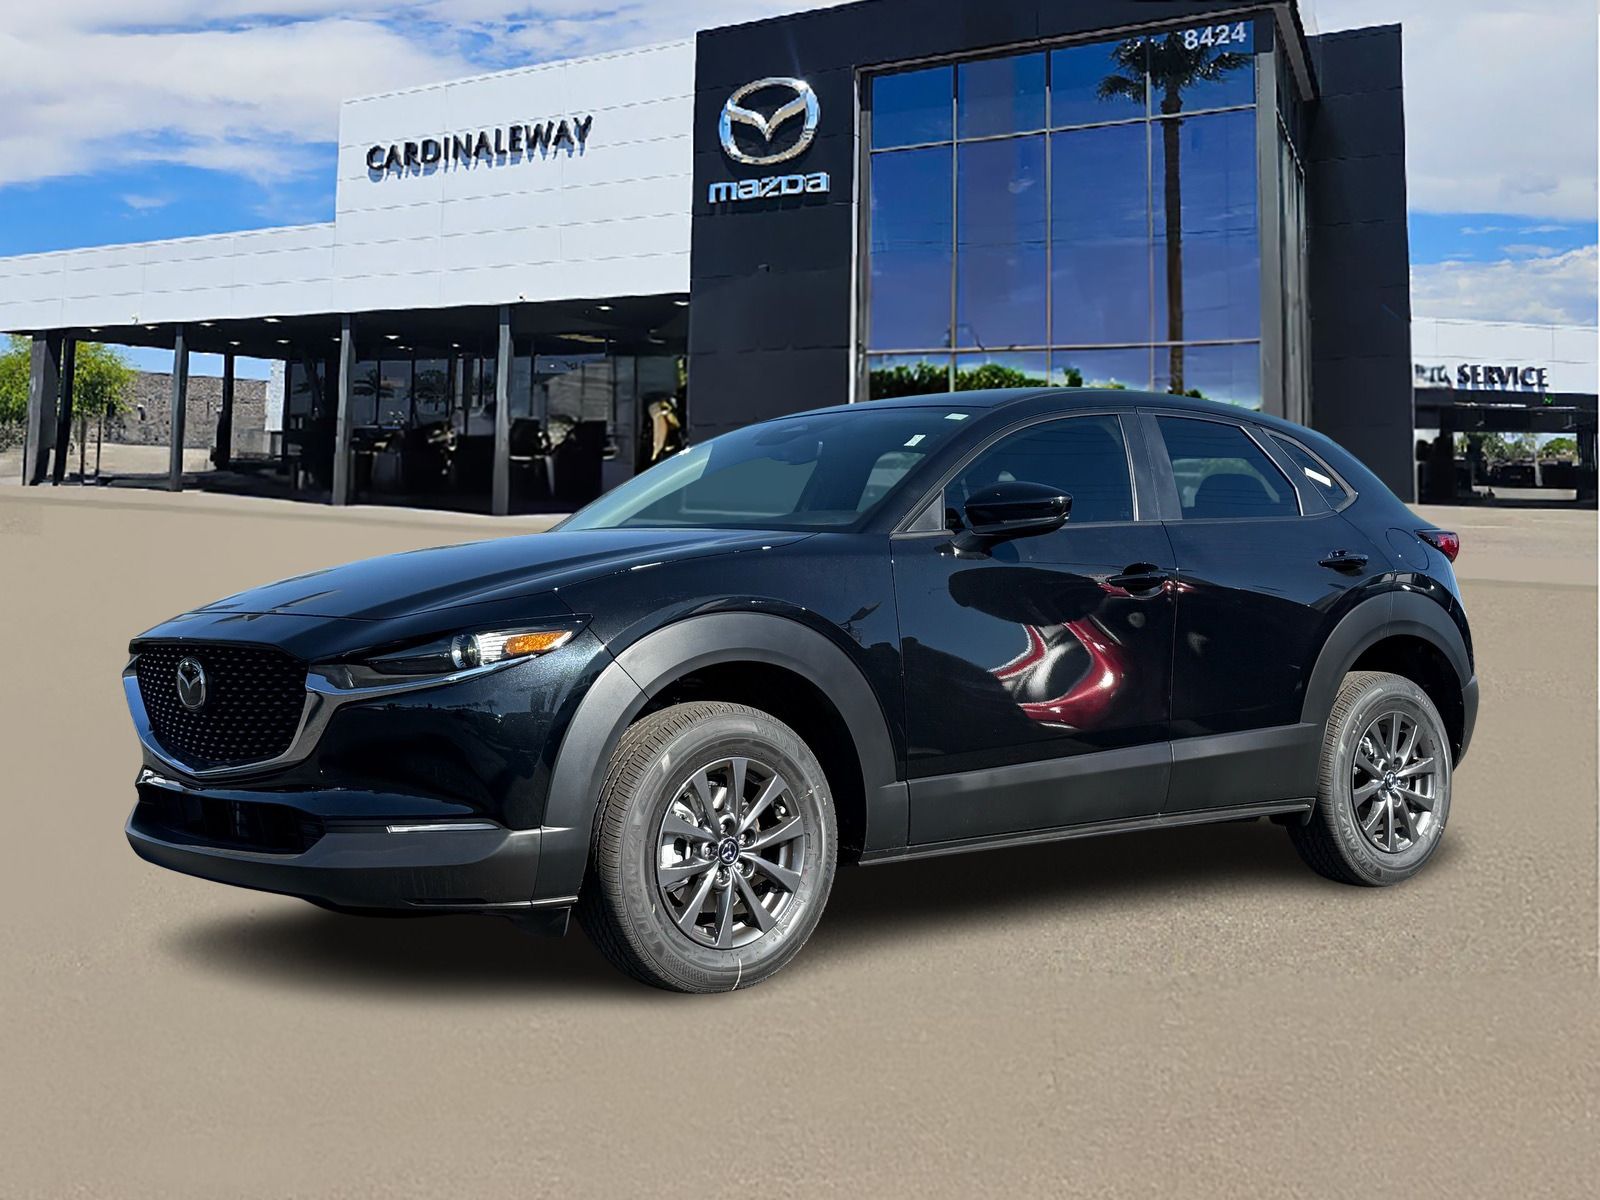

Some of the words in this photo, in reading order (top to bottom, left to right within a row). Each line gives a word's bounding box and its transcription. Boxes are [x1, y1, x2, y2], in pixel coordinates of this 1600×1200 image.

[1184, 21, 1247, 50] 8424
[366, 115, 593, 171] CARDINALEWAY
[1457, 363, 1549, 388] SERVICE
